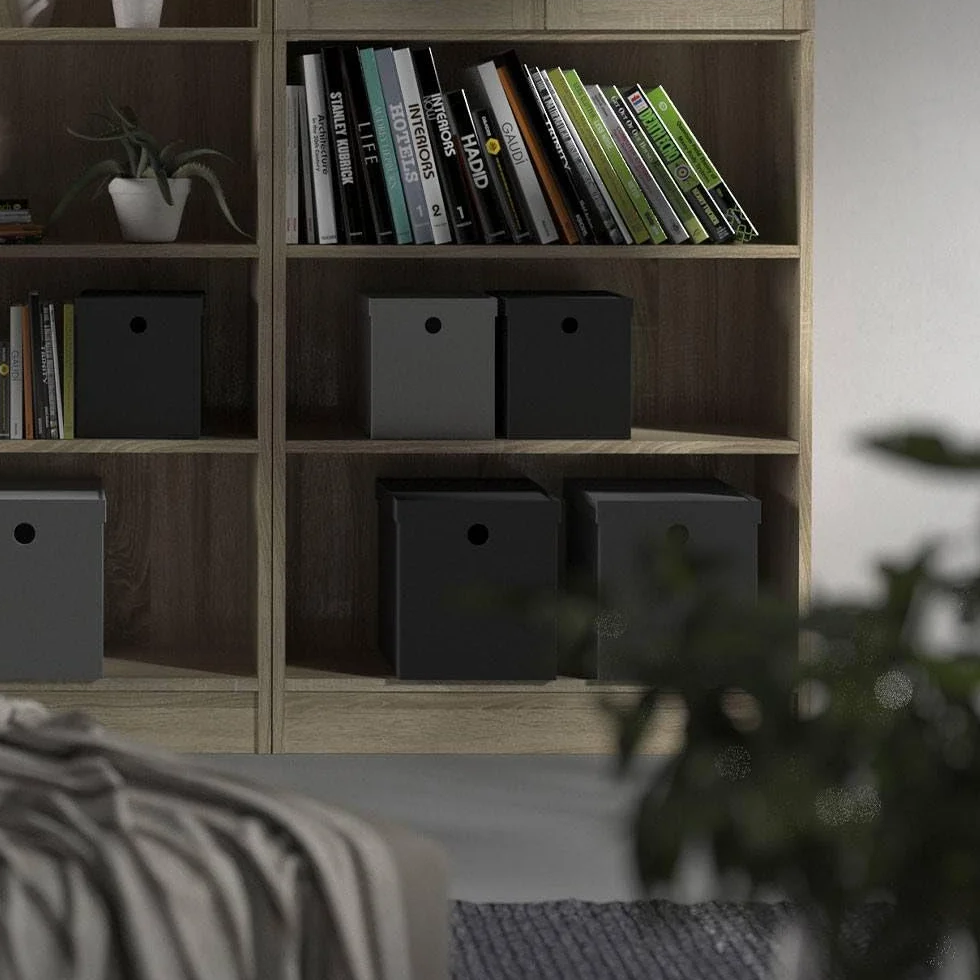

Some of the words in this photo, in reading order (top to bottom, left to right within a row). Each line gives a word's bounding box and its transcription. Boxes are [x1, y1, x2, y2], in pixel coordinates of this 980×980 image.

[330, 92, 347, 135] STANLEY
[431, 92, 456, 157] INTERIORS
[637, 107, 666, 141] DEATH
[655, 134, 681, 163] ECHO
[318, 115, 329, 175] Architecture
[336, 139, 353, 185] KUBRICK
[358, 122, 378, 165] LIFE
[389, 103, 418, 184] HOTELS
[408, 104, 434, 180] INTERIORS
[460, 134, 489, 189] HADID
[432, 204, 440, 217] 2
[456, 206, 465, 219] 1
